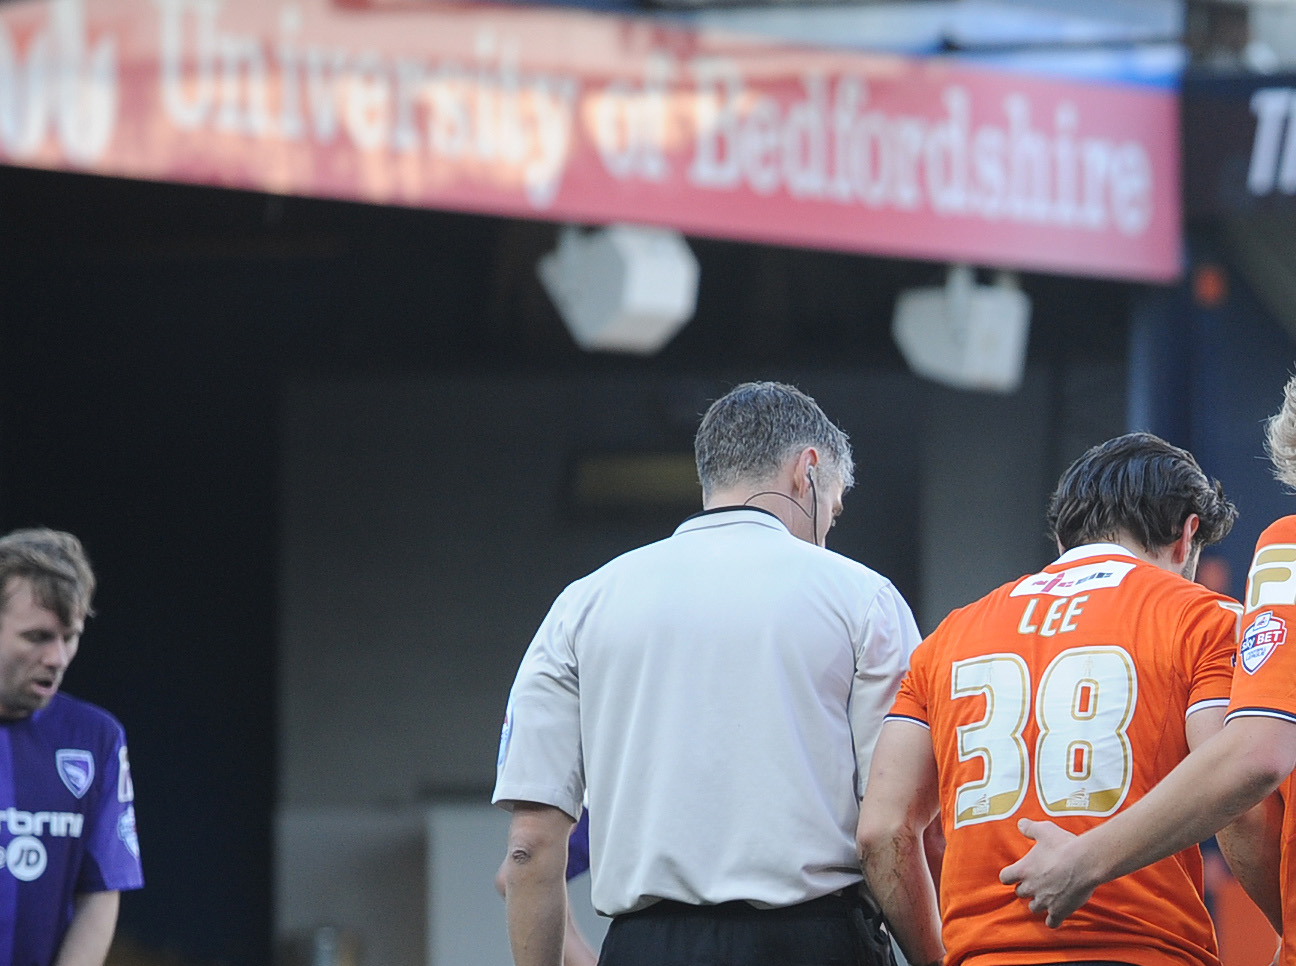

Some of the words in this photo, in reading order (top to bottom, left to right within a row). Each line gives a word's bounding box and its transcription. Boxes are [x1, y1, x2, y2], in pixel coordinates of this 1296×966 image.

[158, 0, 576, 209] University
[584, 48, 676, 184] of
[688, 56, 1154, 237] Bedfordshire
[1017, 594, 1091, 637] LEE
[1256, 629, 1284, 646] BET
[951, 644, 1139, 830] 38
